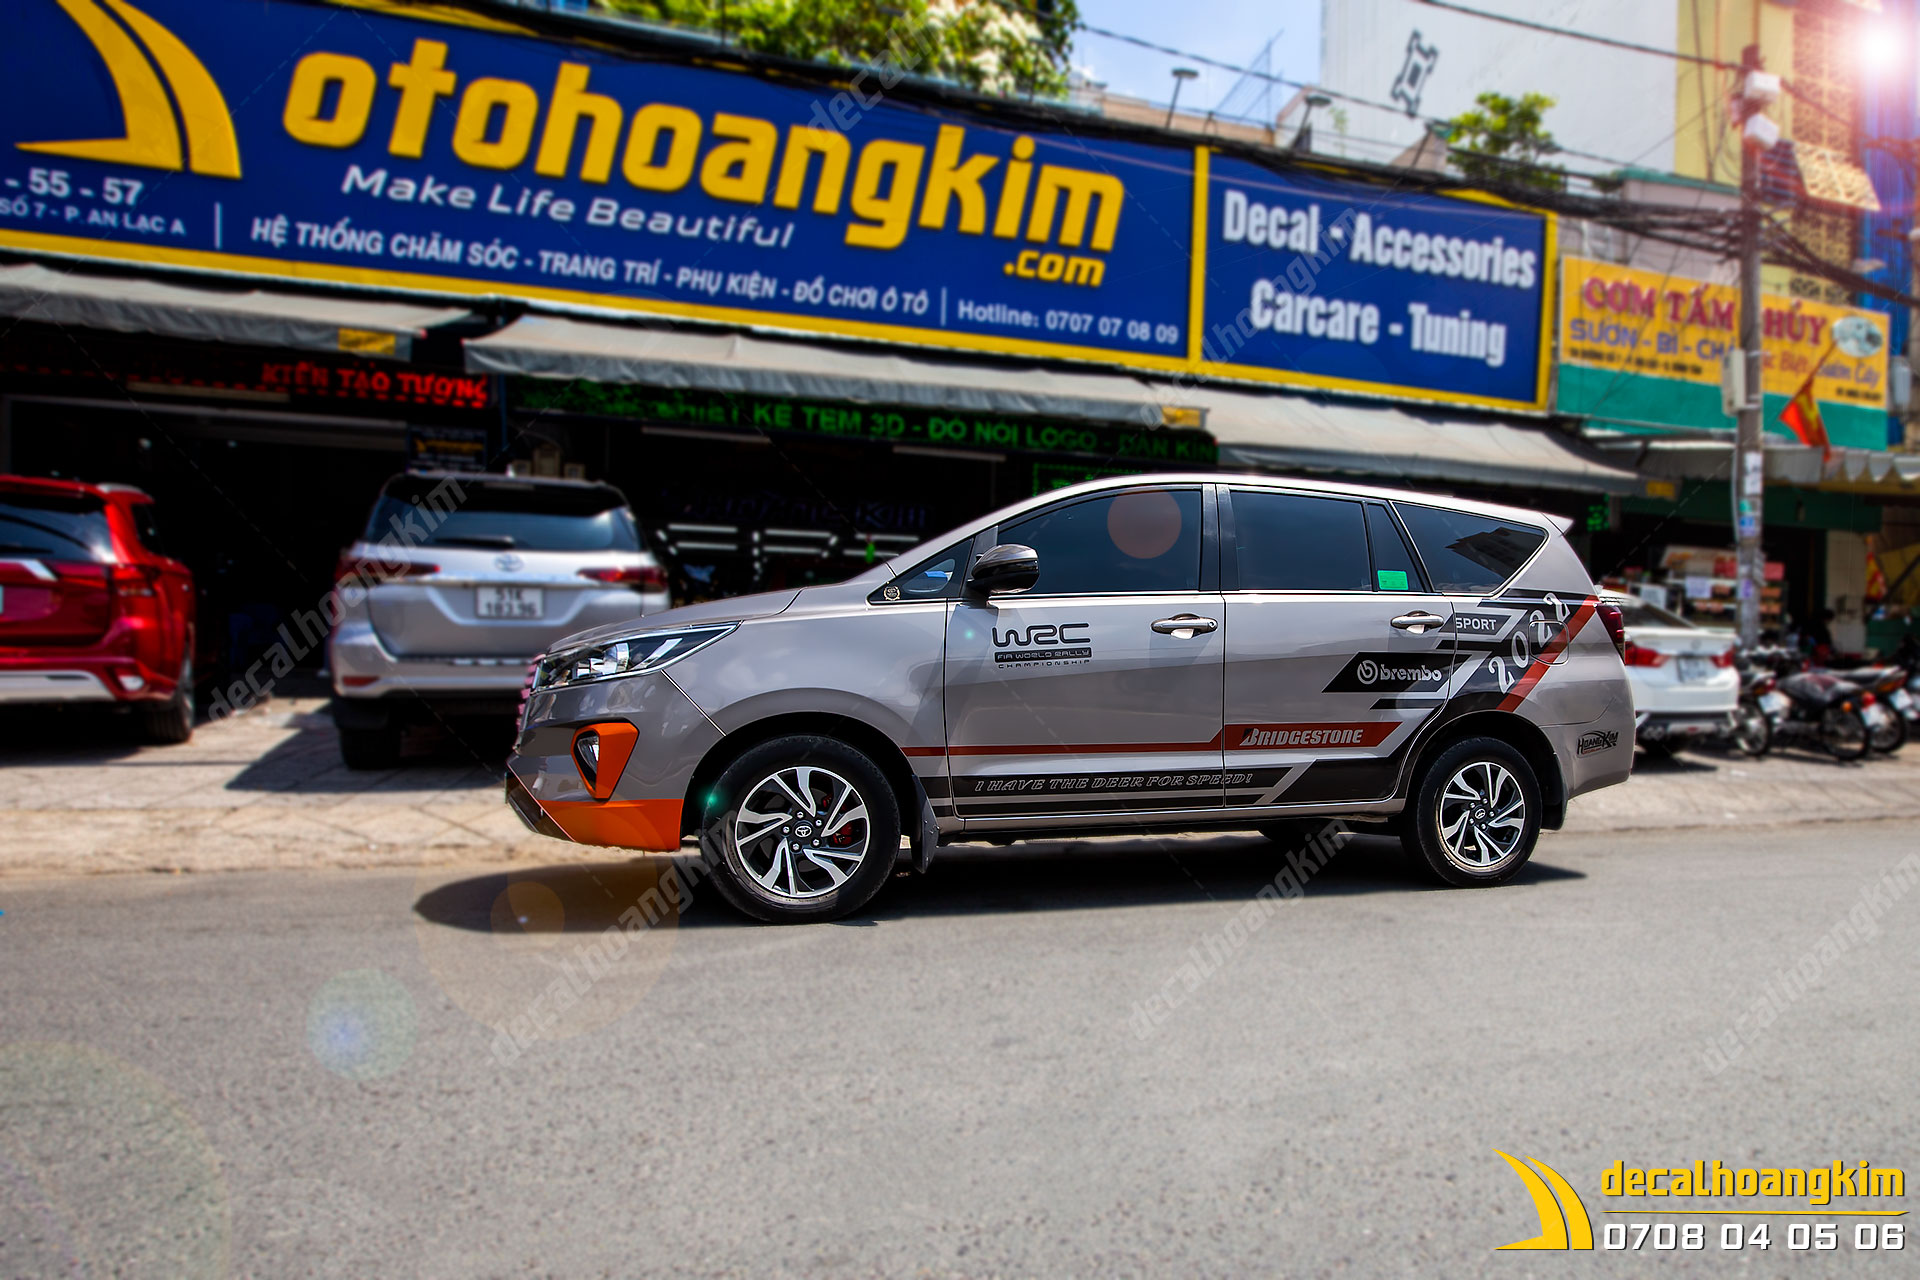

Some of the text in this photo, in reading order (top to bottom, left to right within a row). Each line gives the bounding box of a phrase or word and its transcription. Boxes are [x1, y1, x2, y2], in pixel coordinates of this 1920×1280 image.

[283, 38, 1125, 251] otohoangkim
[28, 167, 71, 198] 55
[103, 177, 144, 206] 57
[34, 202, 46, 219] 7
[88, 209, 118, 228] AN
[170, 218, 187, 236] A
[341, 165, 794, 247] Make Life Beautiful
[1222, 188, 1320, 254] Decal
[1350, 211, 1537, 289] Accessories
[251, 214, 288, 247] HỆ
[390, 231, 463, 263] CHĂM
[467, 238, 519, 269] SÓC
[538, 249, 616, 280] TRANG
[623, 259, 662, 285] TRÍ
[676, 266, 722, 296] PHỤ
[726, 270, 777, 300] KIỆN
[881, 286, 898, 312] Ô
[902, 289, 929, 315] TÔ
[1003, 249, 1106, 287] .com
[958, 299, 1179, 345] Hotline: 0707 07 08 09
[1249, 278, 1380, 345] Carcare
[1408, 302, 1506, 367] Tuning
[800, 404, 863, 434] TEM
[869, 412, 906, 439] 3D
[1025, 424, 1098, 452] LOGO
[992, 622, 1091, 648] WRC
[1455, 617, 1497, 631] SPORT
[997, 649, 1090, 661] FIA WORLD RALLY
[1488, 592, 1571, 695] 2022
[998, 659, 1090, 669] CHAMPIONSHIP
[1380, 663, 1443, 682] brembo
[1239, 728, 1364, 747] BRIDGESTONE
[975, 773, 1253, 792] I HAVE THE DEER FOR SPEED!
